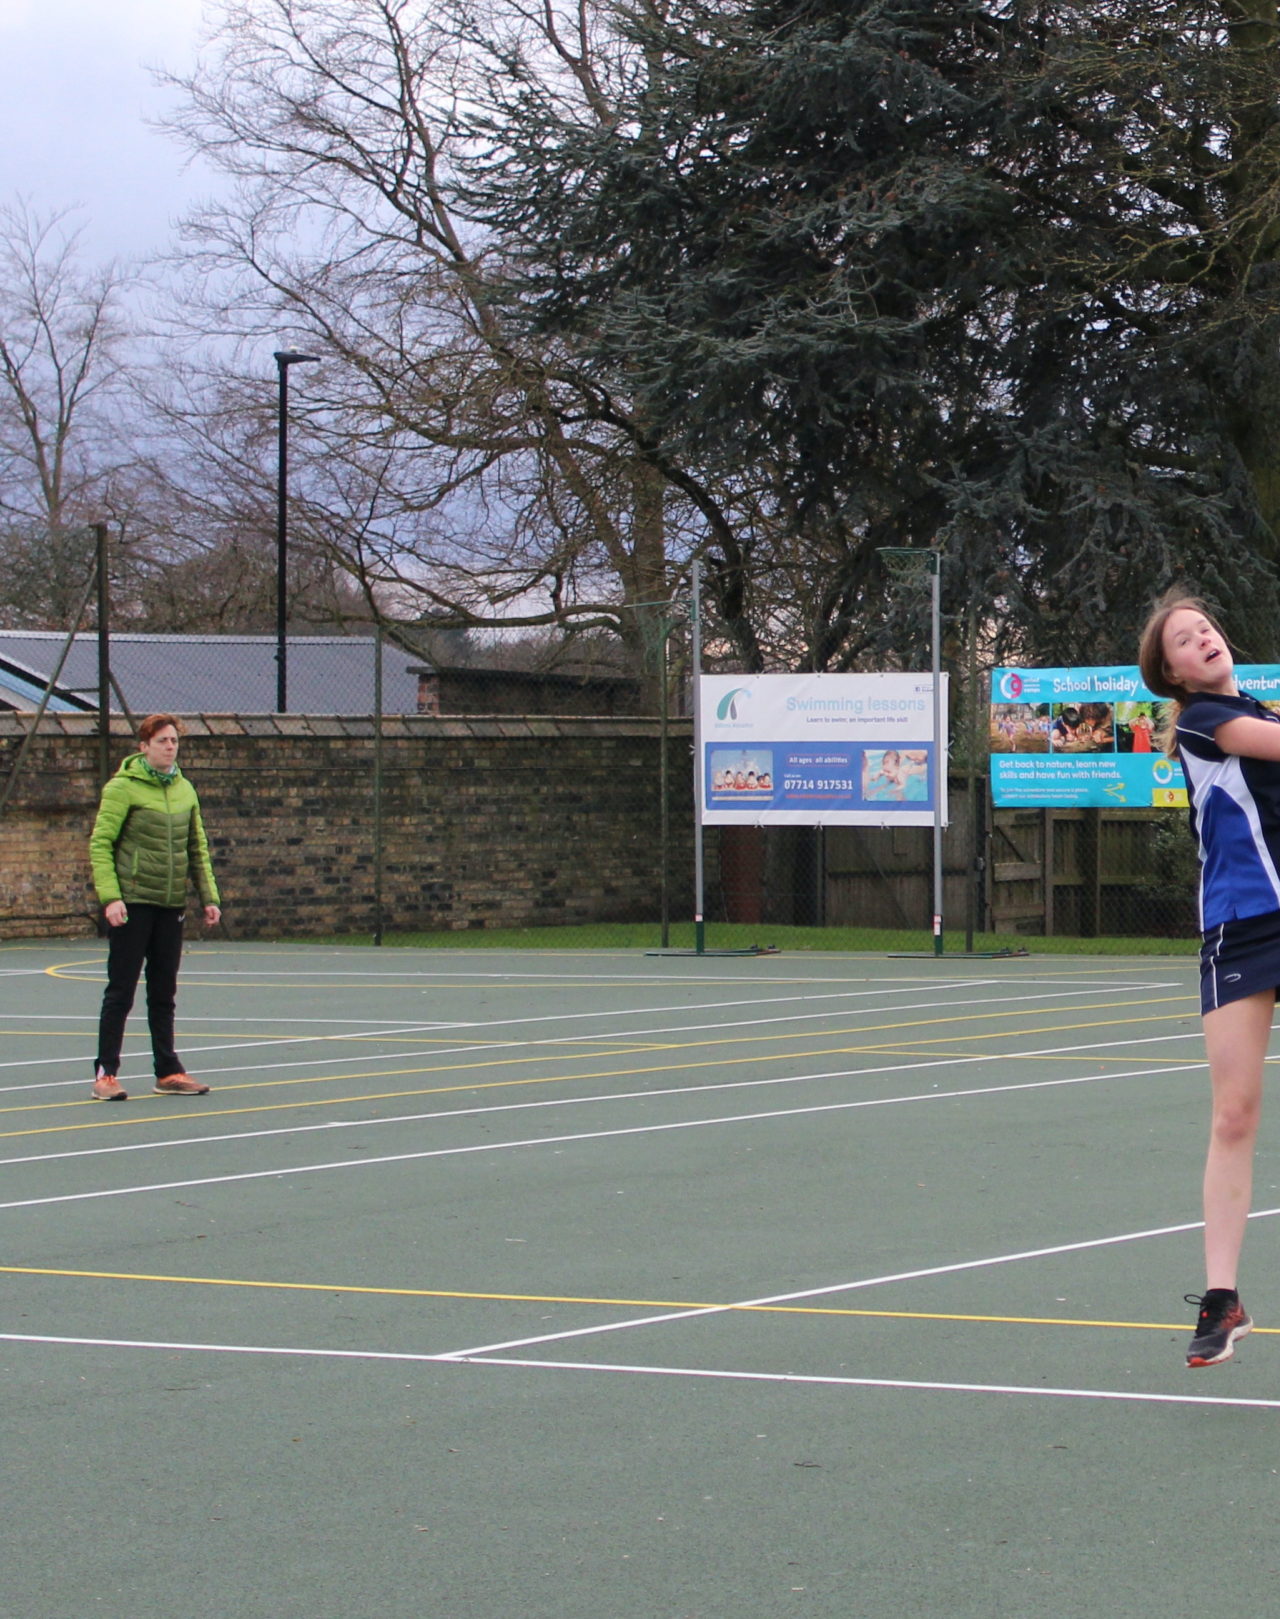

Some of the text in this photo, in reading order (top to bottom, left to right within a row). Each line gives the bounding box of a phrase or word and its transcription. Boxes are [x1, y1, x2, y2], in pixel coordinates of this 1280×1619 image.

[1054, 675, 1091, 693] School
[1094, 675, 1138, 697] holiday
[786, 696, 926, 714] Swimming lessons
[999, 760, 1013, 769] Get
[1015, 760, 1035, 769] back
[1036, 761, 1045, 769] to
[1076, 760, 1097, 768] learn
[1000, 771, 1122, 779] skills and have fun with friends.
[784, 780, 853, 790] 07714 917531
